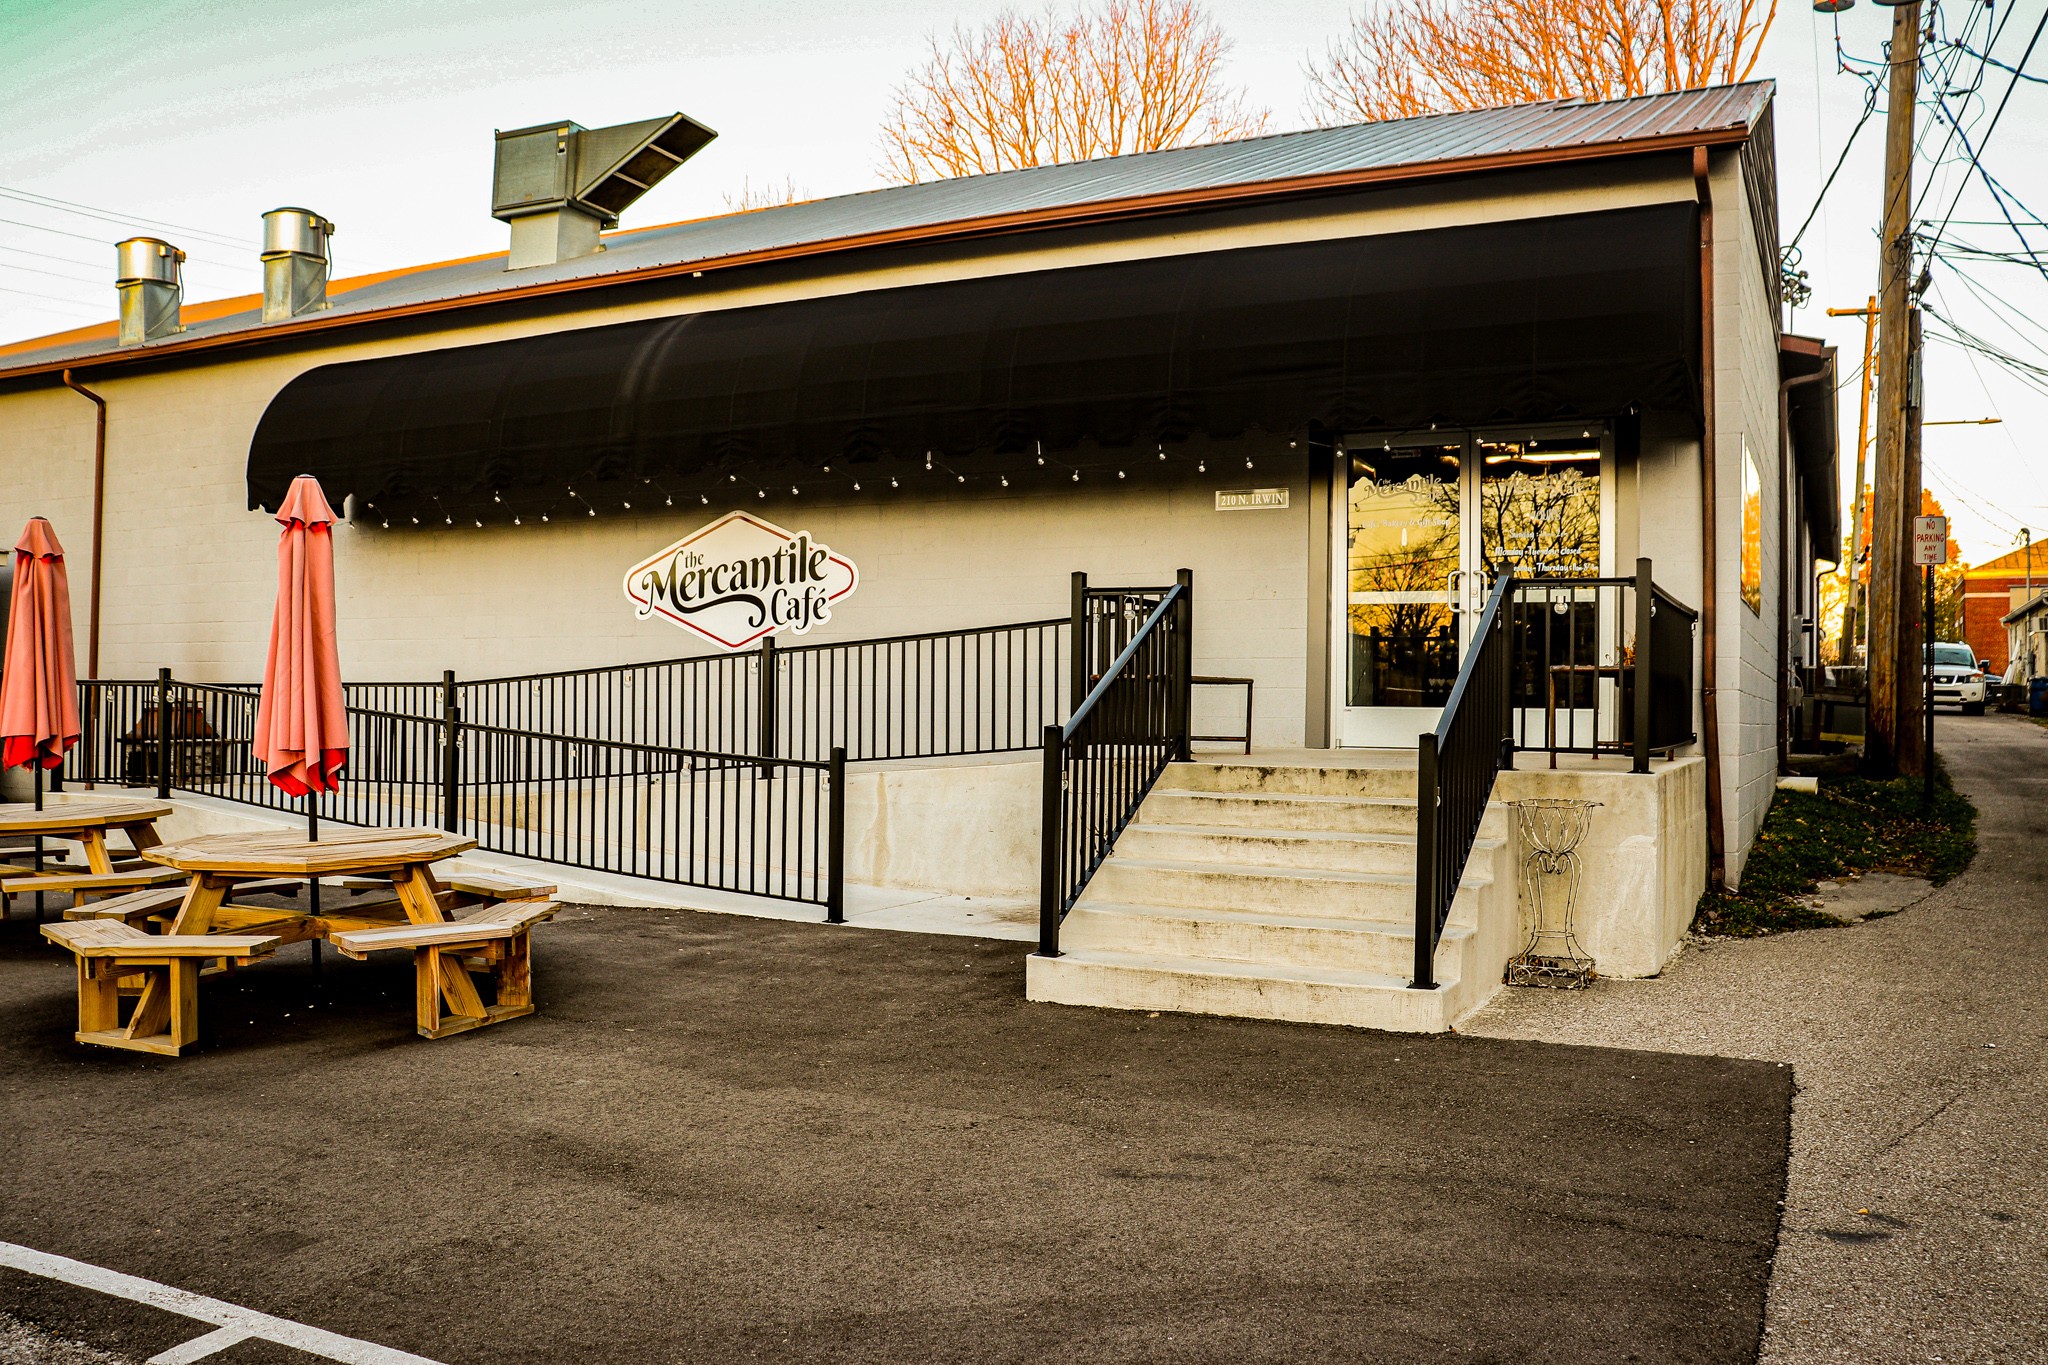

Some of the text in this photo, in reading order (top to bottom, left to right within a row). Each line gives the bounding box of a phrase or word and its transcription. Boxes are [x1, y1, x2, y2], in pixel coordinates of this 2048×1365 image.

[1221, 493, 1283, 506] 210 N. IRWIN
[1432, 517, 1451, 528] Shop
[1926, 521, 1936, 530] NO
[1916, 534, 1944, 542] PARKING
[684, 551, 705, 569] the
[639, 535, 829, 629] Mercantile
[770, 585, 828, 630] Café
